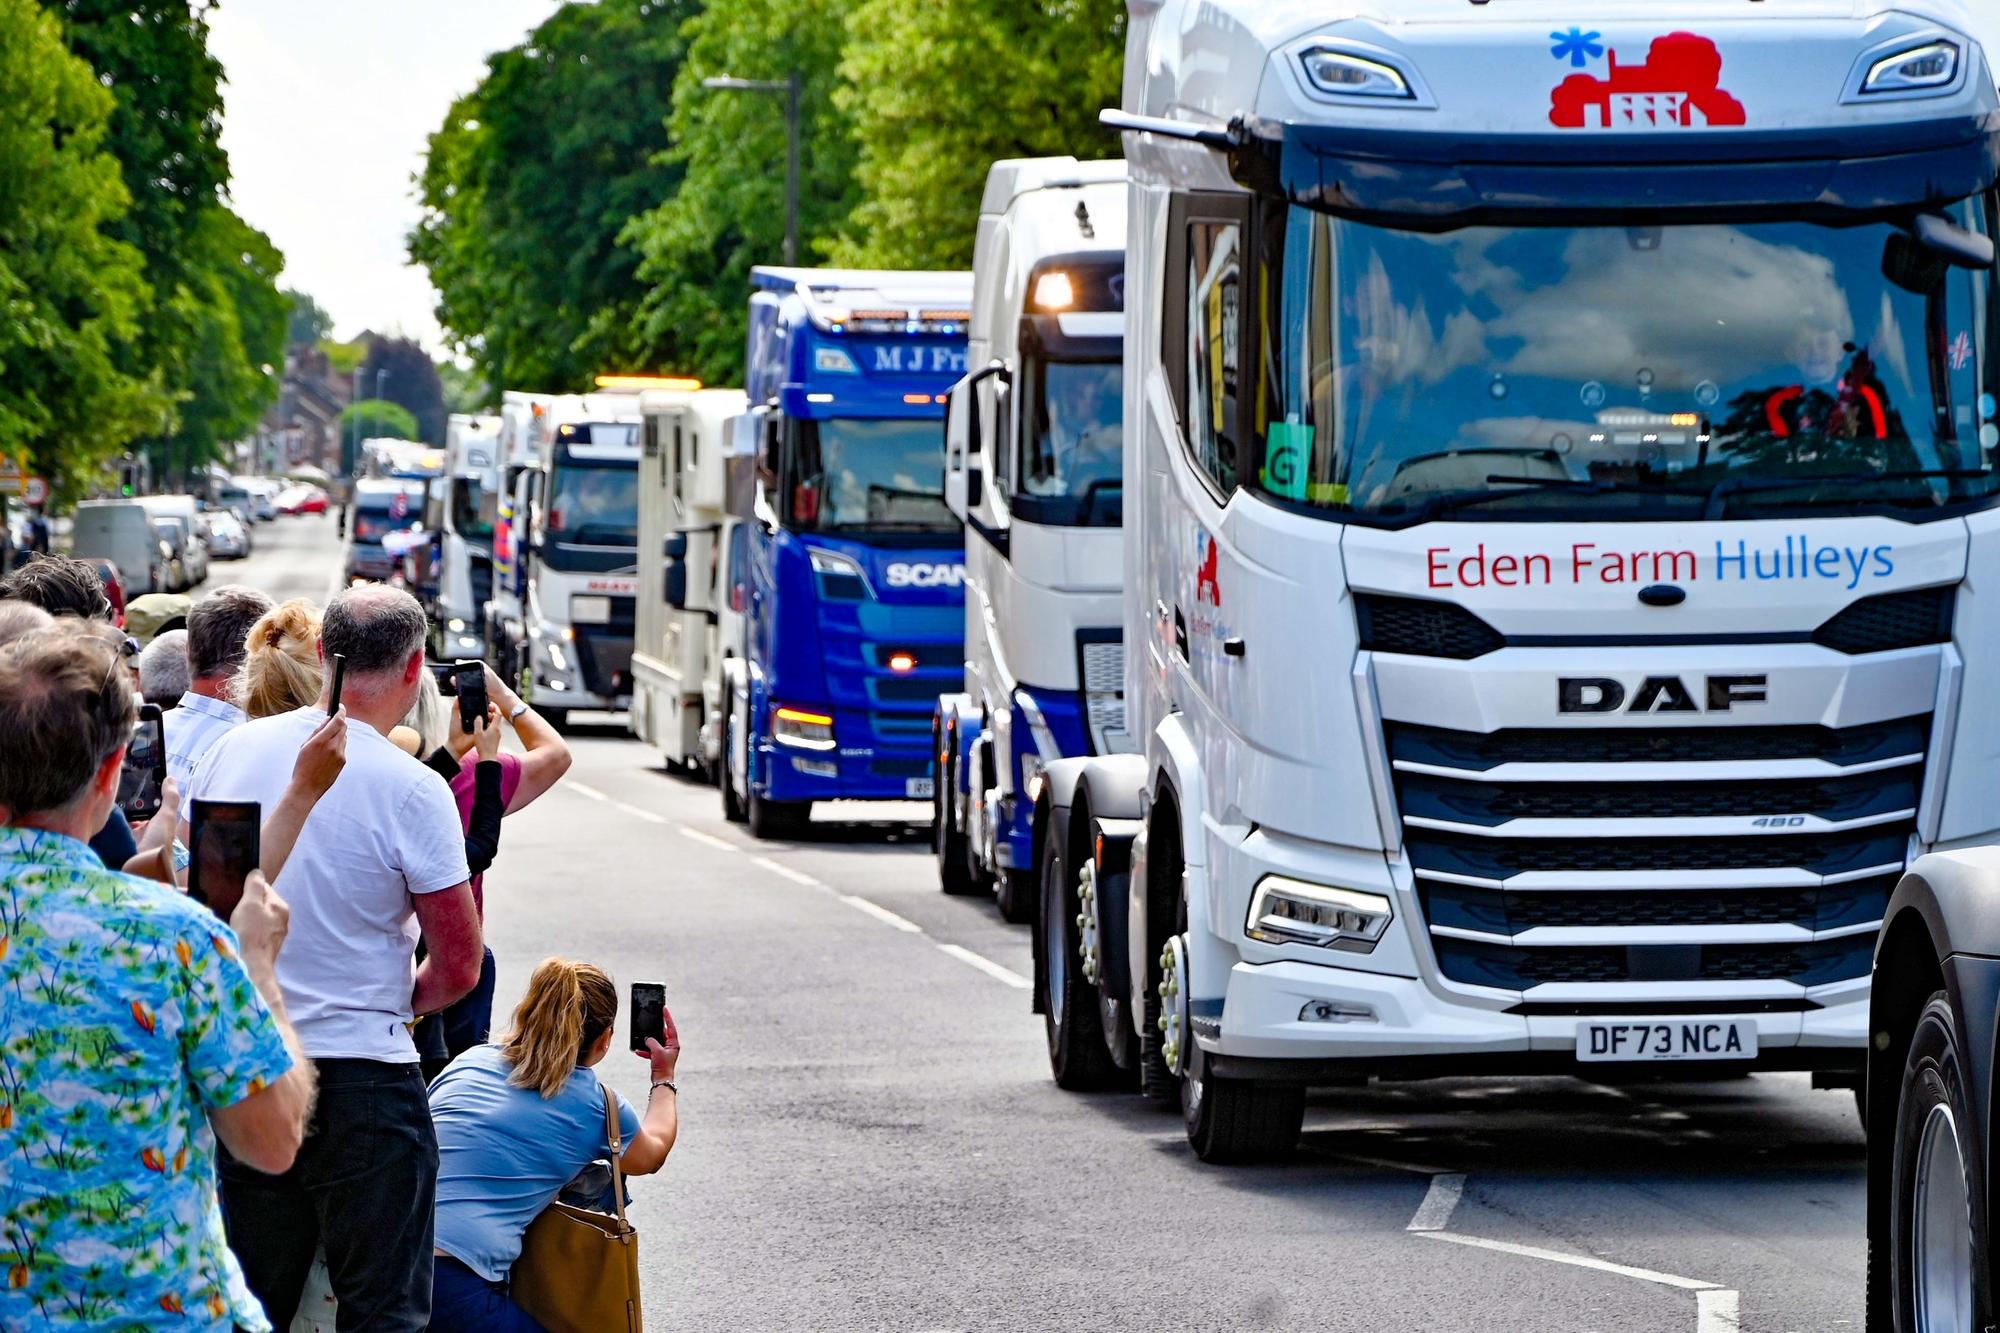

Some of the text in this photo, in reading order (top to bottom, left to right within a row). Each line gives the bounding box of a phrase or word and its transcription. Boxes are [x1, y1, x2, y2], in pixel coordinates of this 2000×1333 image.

[875, 346, 901, 371] M
[907, 346, 924, 371] J
[1270, 446, 1299, 485] G
[1427, 535, 1894, 590] Eden Farm Hulleys
[1557, 674, 1768, 715] DAF
[1752, 816, 1805, 827] 480
[1590, 1023, 1742, 1054] DF73 NCA
